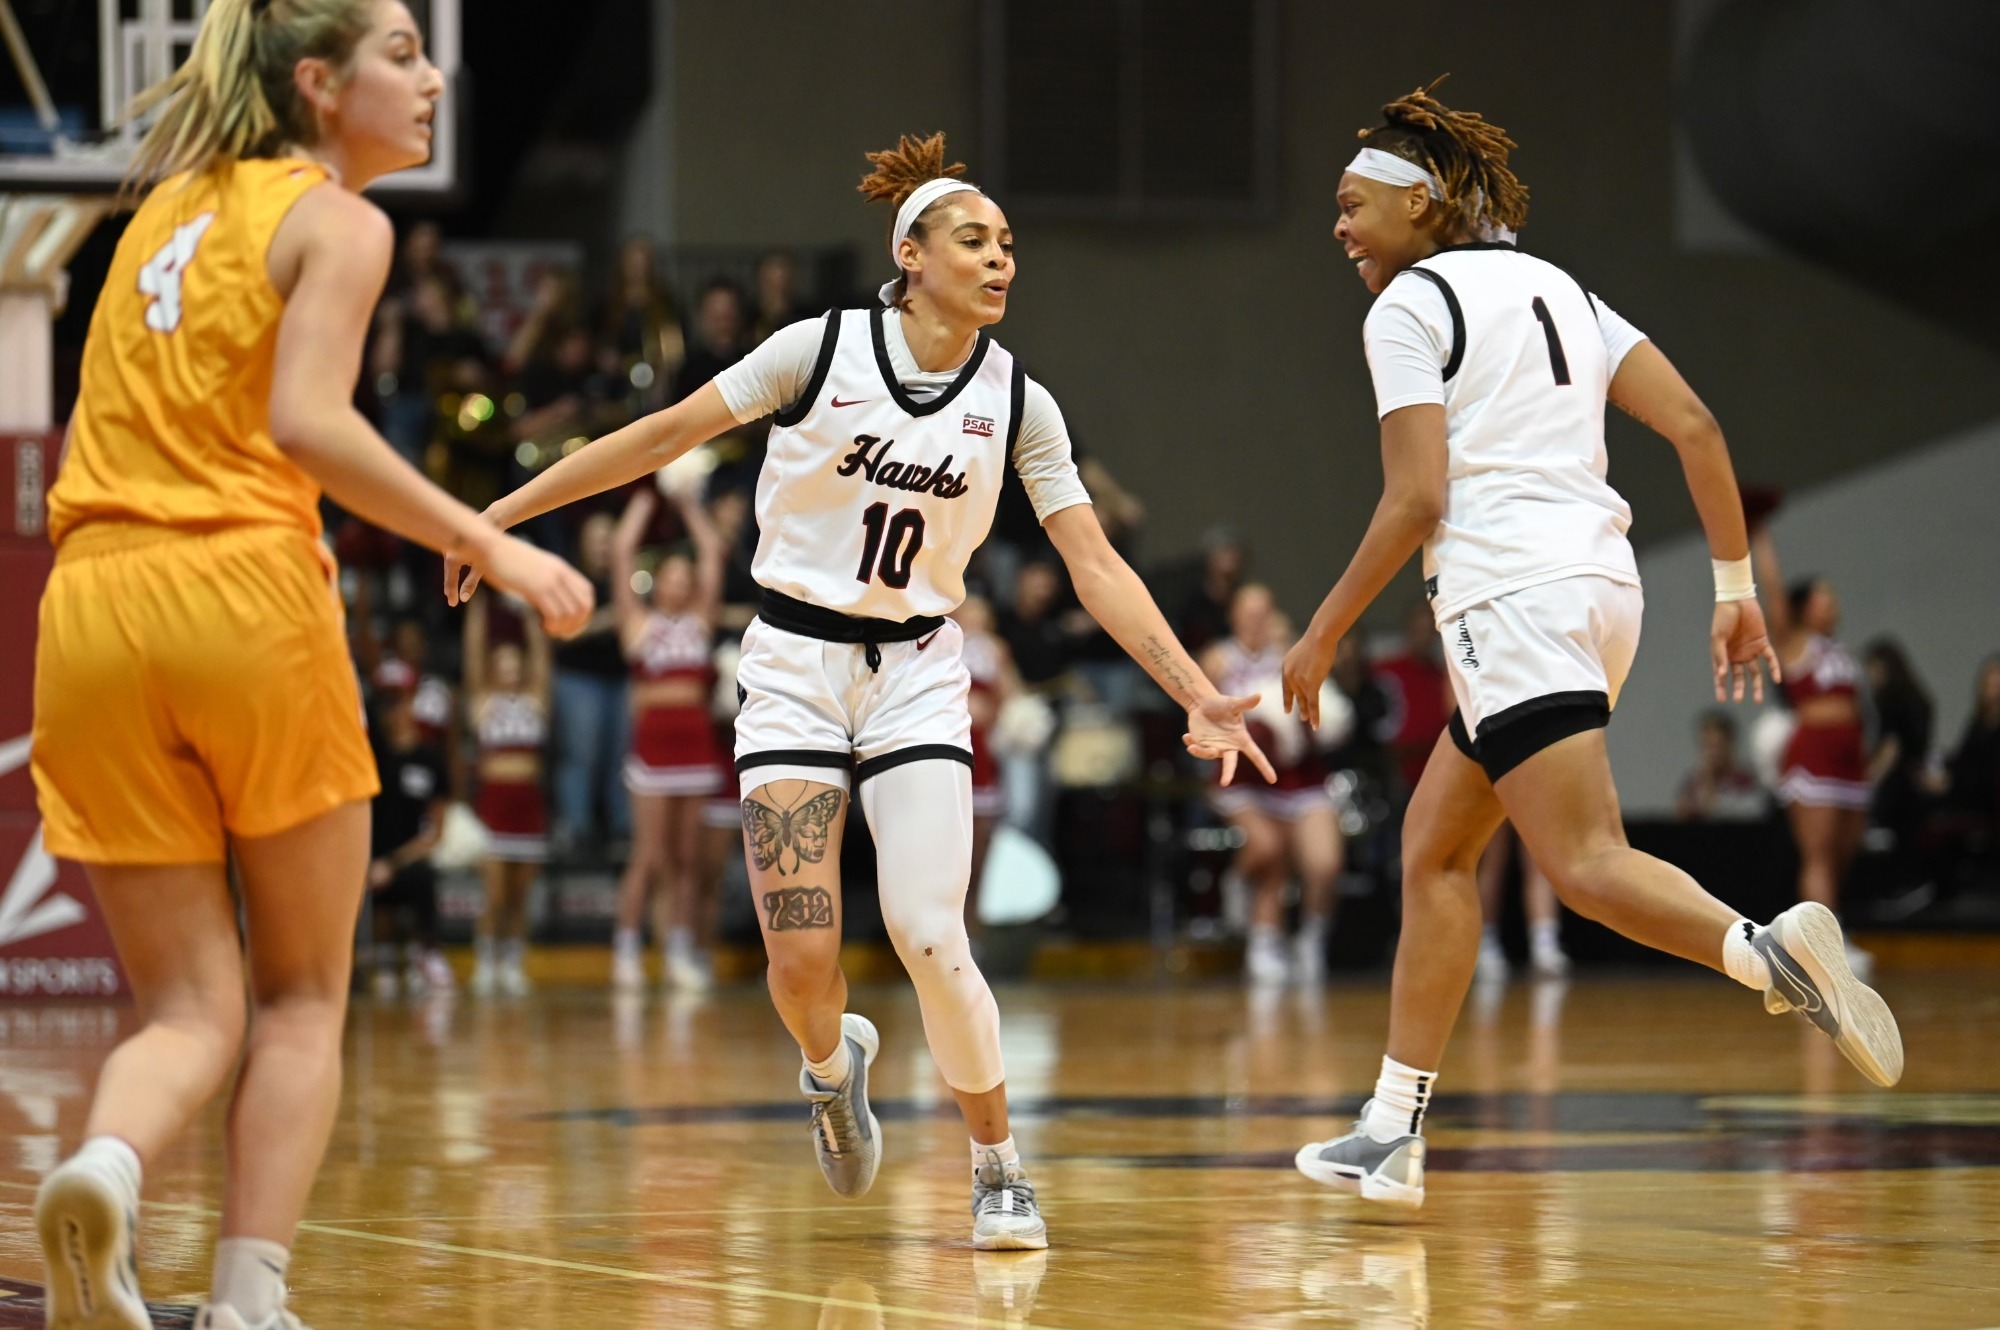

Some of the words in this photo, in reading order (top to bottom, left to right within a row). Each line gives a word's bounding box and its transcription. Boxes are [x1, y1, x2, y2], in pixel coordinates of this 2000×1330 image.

[137, 212, 217, 336] 4
[1531, 295, 1572, 387] 1
[836, 433, 968, 499] Hawks
[962, 418, 995, 433] PSAC
[856, 501, 925, 589] 10
